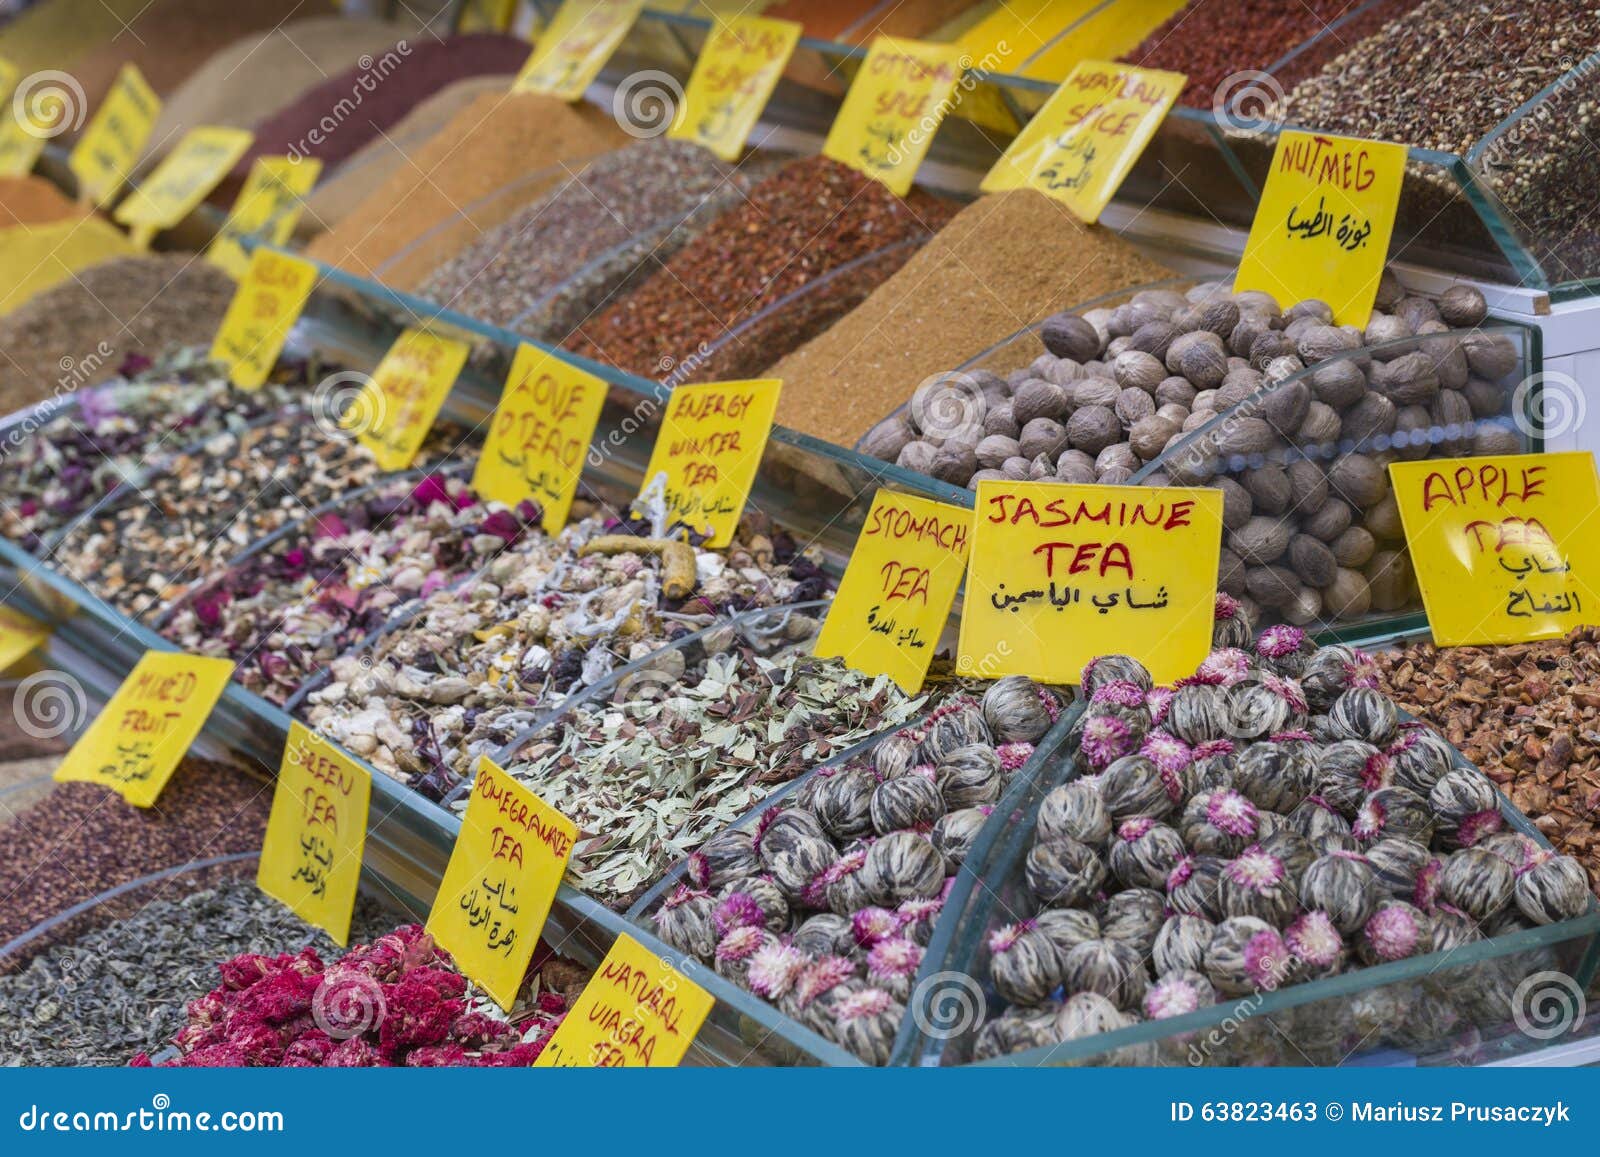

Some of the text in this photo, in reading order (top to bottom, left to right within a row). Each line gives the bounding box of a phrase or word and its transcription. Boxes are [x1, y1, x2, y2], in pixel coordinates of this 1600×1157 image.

[1063, 103, 1139, 136] SPICE
[1279, 136, 1376, 193] NUTMEG
[516, 364, 586, 423] LOVE
[671, 393, 755, 423] ENERGY
[669, 430, 742, 458] WINTER
[683, 461, 719, 488] TEA
[1422, 463, 1547, 512] APPLE
[865, 505, 968, 554] STOMACH
[989, 494, 1196, 531] JASMINE
[1463, 516, 1557, 554] TEA
[1032, 541, 1135, 581] TEA
[880, 560, 930, 607] TEA
[1091, 586, 1169, 615] شاي
[302, 786, 338, 836] TEA
[491, 826, 524, 871] TEA
[600, 961, 680, 1036] NATURAL
